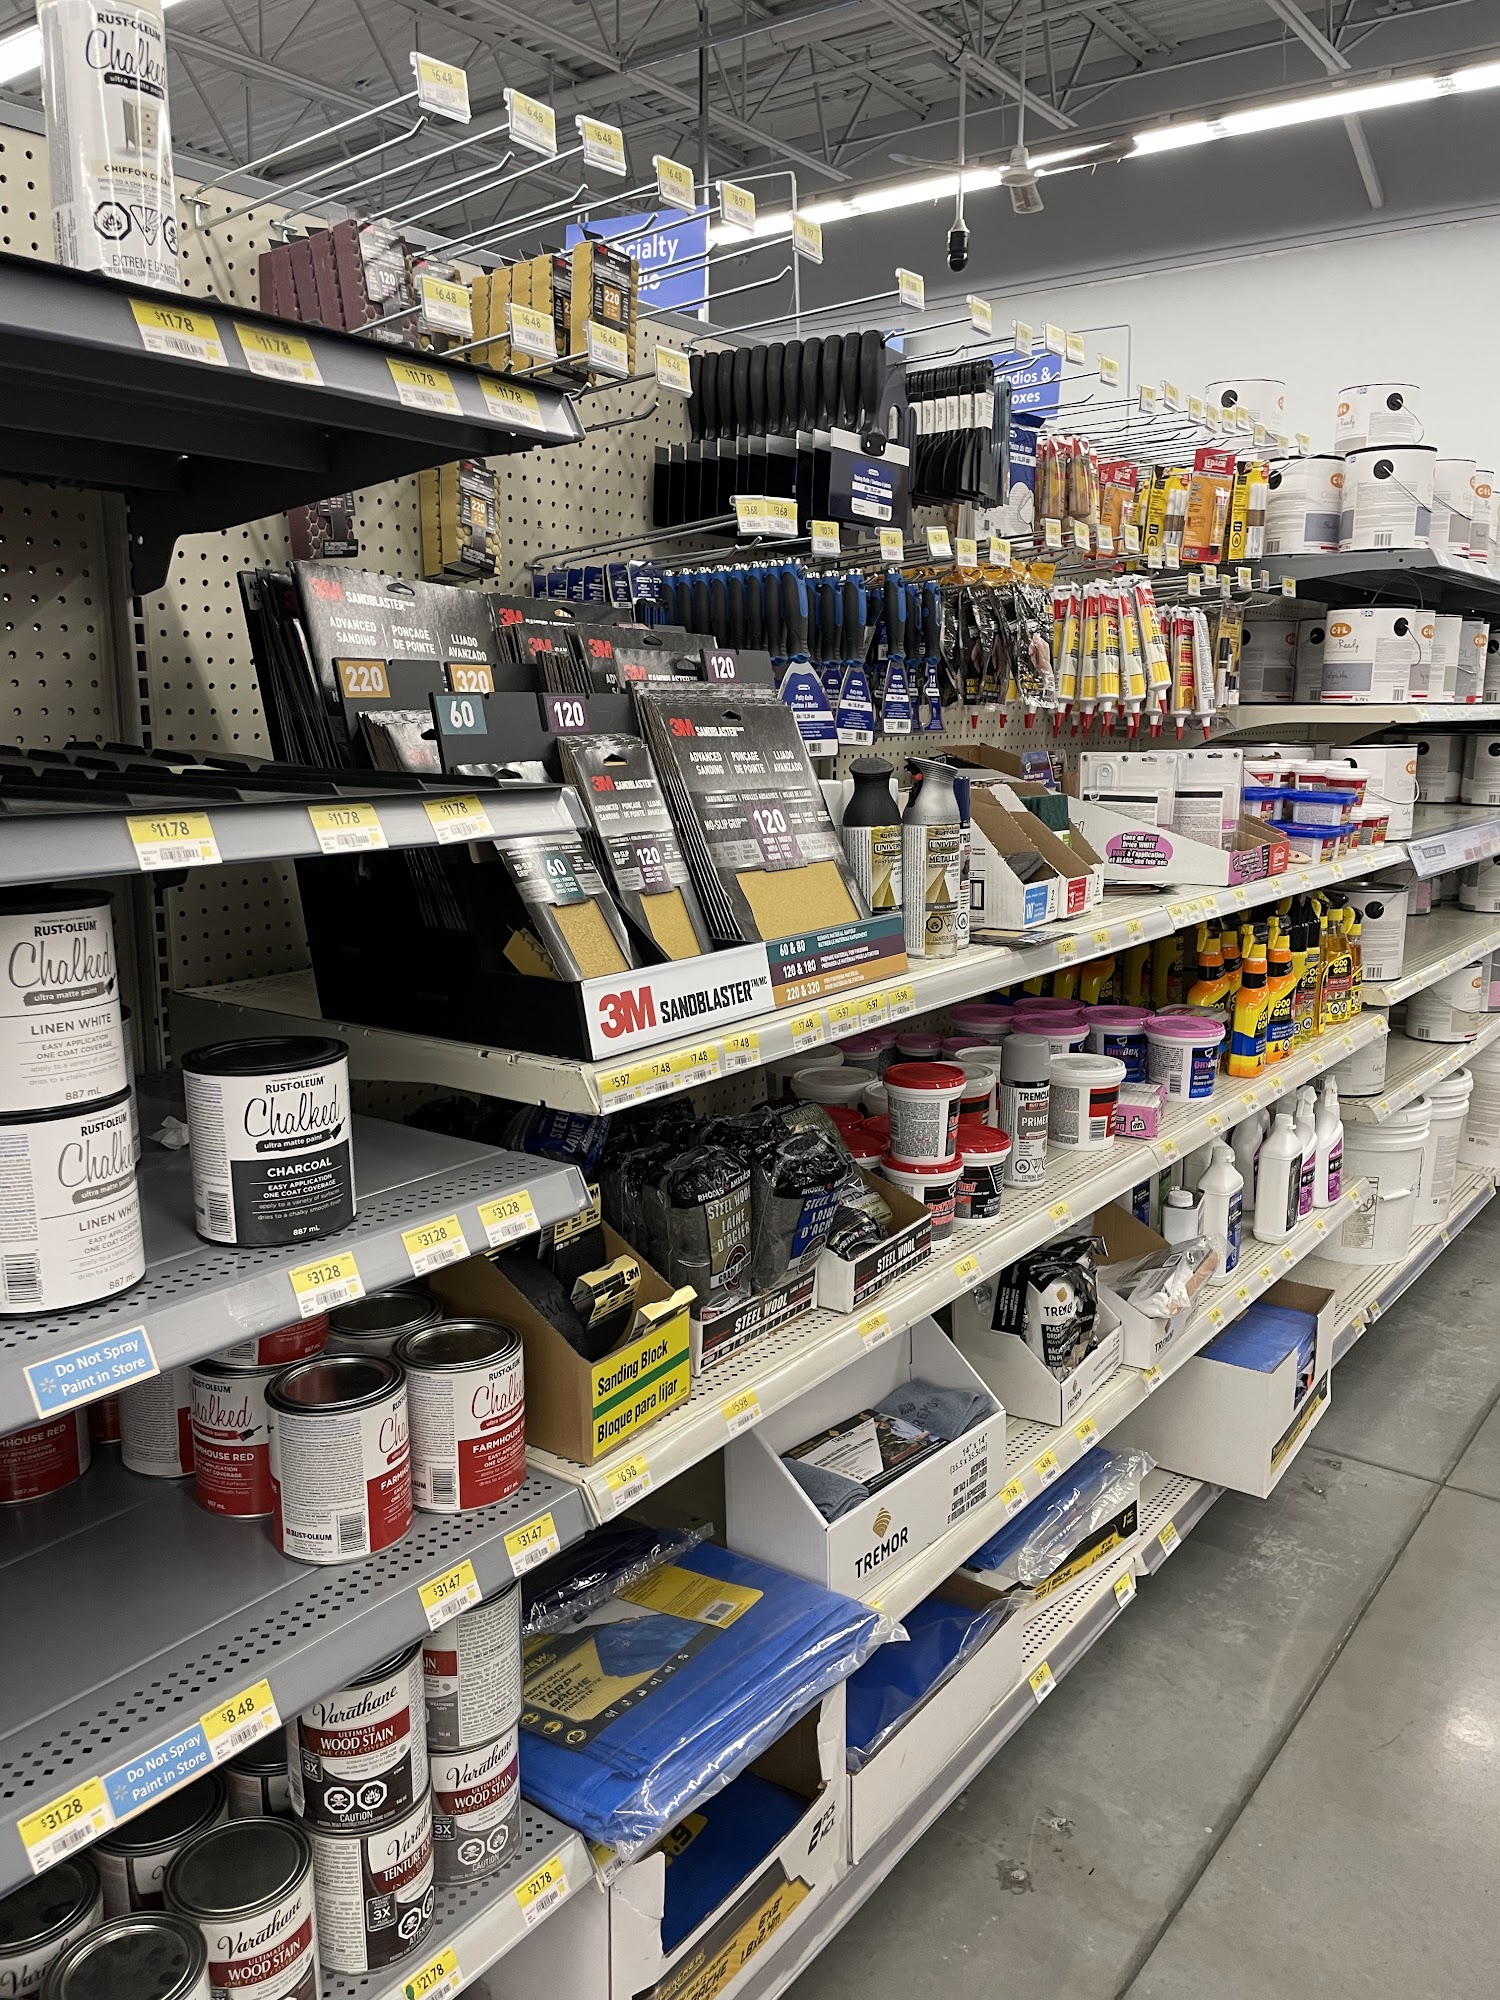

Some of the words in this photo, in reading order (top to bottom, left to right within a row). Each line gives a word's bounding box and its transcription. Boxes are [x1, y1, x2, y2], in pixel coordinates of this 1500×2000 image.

[379, 270, 396, 286] 120
[604, 291, 620, 306] 220
[1012, 391, 1041, 405] oxes
[329, 616, 377, 633] ADVANCED
[336, 631, 377, 647] SANDING
[393, 639, 405, 651] DE
[405, 640, 436, 655] POINTE
[450, 633, 478, 648] LIJADO
[588, 638, 612, 659] 3M
[448, 647, 487, 662] AVANZADO
[711, 655, 736, 679] 120
[345, 666, 384, 693] 220
[456, 670, 490, 693] 320
[450, 700, 474, 729] 60
[553, 701, 585, 727] 120
[669, 717, 696, 737] 3M
[689, 751, 723, 762] ADVANCED
[731, 751, 760, 763] PONÇAGE
[773, 750, 795, 760] LIJADO
[696, 764, 725, 775] SANDING
[734, 764, 744, 775] DE
[743, 763, 766, 775] POINTE
[773, 762, 803, 772] AVANZADO
[599, 811, 620, 821] SANDING
[753, 808, 787, 835] 120
[636, 846, 661, 866] 120
[546, 858, 567, 877] 60
[34, 920, 98, 938] RUST-OLEUM
[780, 943, 789, 957] 60
[790, 942, 797, 954] &
[796, 939, 806, 953] 80
[8, 932, 113, 988] Chalked
[783, 963, 797, 978] 120
[797, 962, 804, 976] &
[804, 959, 817, 974] 180
[1333, 959, 1348, 967] GOO
[1333, 966, 1348, 974] GONE
[34, 993, 55, 1002] ultra
[56, 988, 79, 1000] matte
[80, 986, 98, 998] paint
[786, 985, 800, 1000] 220
[800, 984, 808, 997] &
[808, 980, 820, 996] 320
[598, 986, 657, 1039] 3M
[1273, 1006, 1291, 1017] GONE
[1276, 998, 1291, 1008] GOO
[31, 1020, 75, 1036] LINEN
[75, 1012, 112, 1030] WHITE
[36, 1051, 56, 1060] ONE
[57, 1047, 79, 1058] COAT
[80, 1040, 113, 1054] COVERAGE
[41, 1041, 64, 1051] EASY
[66, 1033, 109, 1048] APPLICATION
[65, 1089, 84, 1101] 887
[87, 1086, 102, 1096] mL
[265, 1076, 326, 1094] RUST-OLEUM
[244, 1084, 341, 1138] Chalked
[80, 1112, 128, 1137] RUST-OLEUM
[264, 1141, 282, 1150] ultra
[283, 1138, 305, 1147] matte
[306, 1133, 323, 1146] paint
[267, 1156, 333, 1178] CHARCOAL
[263, 1191, 280, 1199] ONE
[281, 1187, 302, 1198] COAT
[303, 1179, 337, 1194] COVERAGE
[268, 1183, 289, 1192] EASY
[289, 1173, 333, 1189] APPLICATION
[697, 1186, 725, 1203] RHODES
[493, 1200, 520, 1219] $31.28
[707, 1201, 733, 1221] STEEL
[721, 1208, 746, 1234] LAINE
[717, 1221, 751, 1254] D'ACIER
[876, 1251, 896, 1274] STEEL
[896, 1237, 916, 1262] WOOL
[109, 1278, 125, 1290] 887
[307, 1262, 341, 1286] $31.28
[625, 1266, 640, 1282] 3M
[734, 1307, 762, 1333] STEEL
[764, 1292, 788, 1317] WOOL
[55, 1362, 75, 1378] Do
[77, 1352, 102, 1370] Not
[104, 1339, 139, 1360] Spray
[597, 1358, 639, 1397] Sanding
[640, 1339, 668, 1371] Block
[61, 1377, 96, 1396] Paint
[97, 1369, 110, 1383] in
[115, 1357, 146, 1377] Store
[596, 1408, 633, 1444] Bloque
[634, 1394, 657, 1424] para
[658, 1378, 678, 1405] lijar
[472, 1425, 520, 1455] FARMHOUSE
[232, 1452, 255, 1462] RED
[517, 1525, 543, 1547] $31.47
[854, 1526, 909, 1578] TREMOR
[433, 1573, 461, 1597] $31.47
[538, 1677, 572, 1703] TARP
[221, 1697, 255, 1723] $8.48
[320, 1734, 360, 1751] WOOD
[362, 1725, 394, 1745] STAIN
[338, 1725, 376, 1738] ULTIMATE
[126, 1767, 144, 1783] Do
[145, 1753, 169, 1772] Not
[170, 1733, 202, 1757] Spray
[132, 1779, 163, 1802] Paint
[164, 1769, 176, 1785] in
[177, 1750, 207, 1775] Store
[303, 1761, 319, 1776] 3X
[454, 1788, 487, 1809] WOOD
[487, 1772, 513, 1801] STAIN
[41, 1798, 84, 1830] $31.28
[339, 1811, 373, 1823] CAUTION
[435, 1824, 451, 1835] 3X
[807, 1817, 822, 1856] 2
[383, 1851, 421, 1883] TEINTURE
[527, 1871, 553, 1896] $21.78
[227, 1961, 271, 1982] WOOD
[273, 1936, 301, 1968] STAIN
[416, 1963, 445, 1991] $21.78
